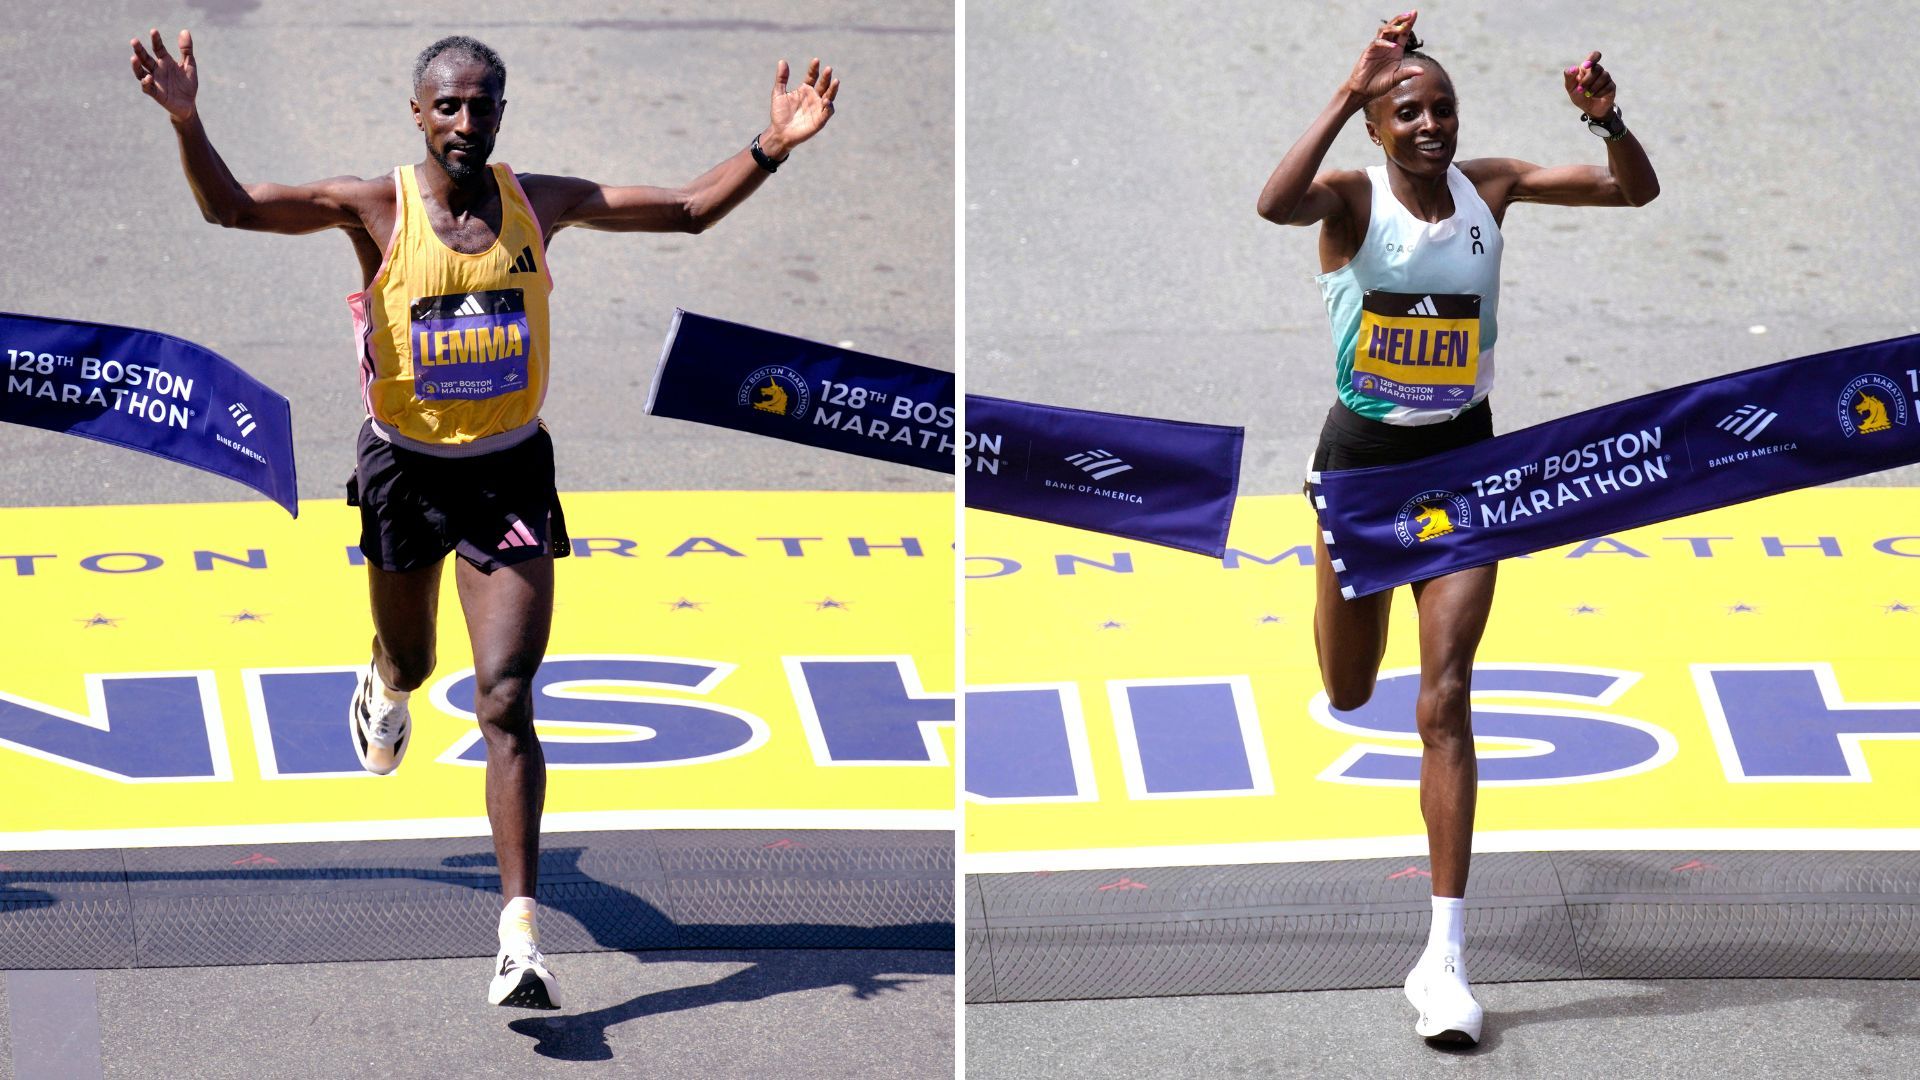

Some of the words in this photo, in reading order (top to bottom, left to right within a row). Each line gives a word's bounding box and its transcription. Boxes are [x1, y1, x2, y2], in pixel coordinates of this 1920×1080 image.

[420, 323, 523, 367] LEMMA
[1368, 324, 1468, 367] HELLEN
[7, 349, 74, 375] 128TH
[80, 356, 194, 402] BOSTON
[459, 379, 492, 387] BOSTON
[1399, 384, 1433, 394] BOSTON
[740, 384, 750, 402] 2024
[750, 367, 784, 385] BOSTON
[788, 371, 808, 415] MARATHON
[821, 379, 887, 409] 128TH
[1841, 377, 1868, 405] BOSTON
[1873, 376, 1905, 419] MARATHON
[1842, 409, 1853, 433] 2024
[216, 433, 231, 448] BANK
[232, 442, 242, 452] OF
[241, 446, 266, 465] AMERICA
[1472, 462, 1538, 497] 128TH
[1543, 426, 1662, 481] BOSTON
[1709, 456, 1735, 468] BANK
[1736, 451, 1749, 461] OF
[1751, 442, 1798, 457] AMERICA
[1045, 480, 1075, 491] BANK
[1078, 485, 1092, 494] OF
[1094, 488, 1143, 504] AMERICA
[1400, 493, 1430, 520] BOSTON
[1435, 492, 1470, 525] MARATHON
[1397, 521, 1410, 542] 2024
